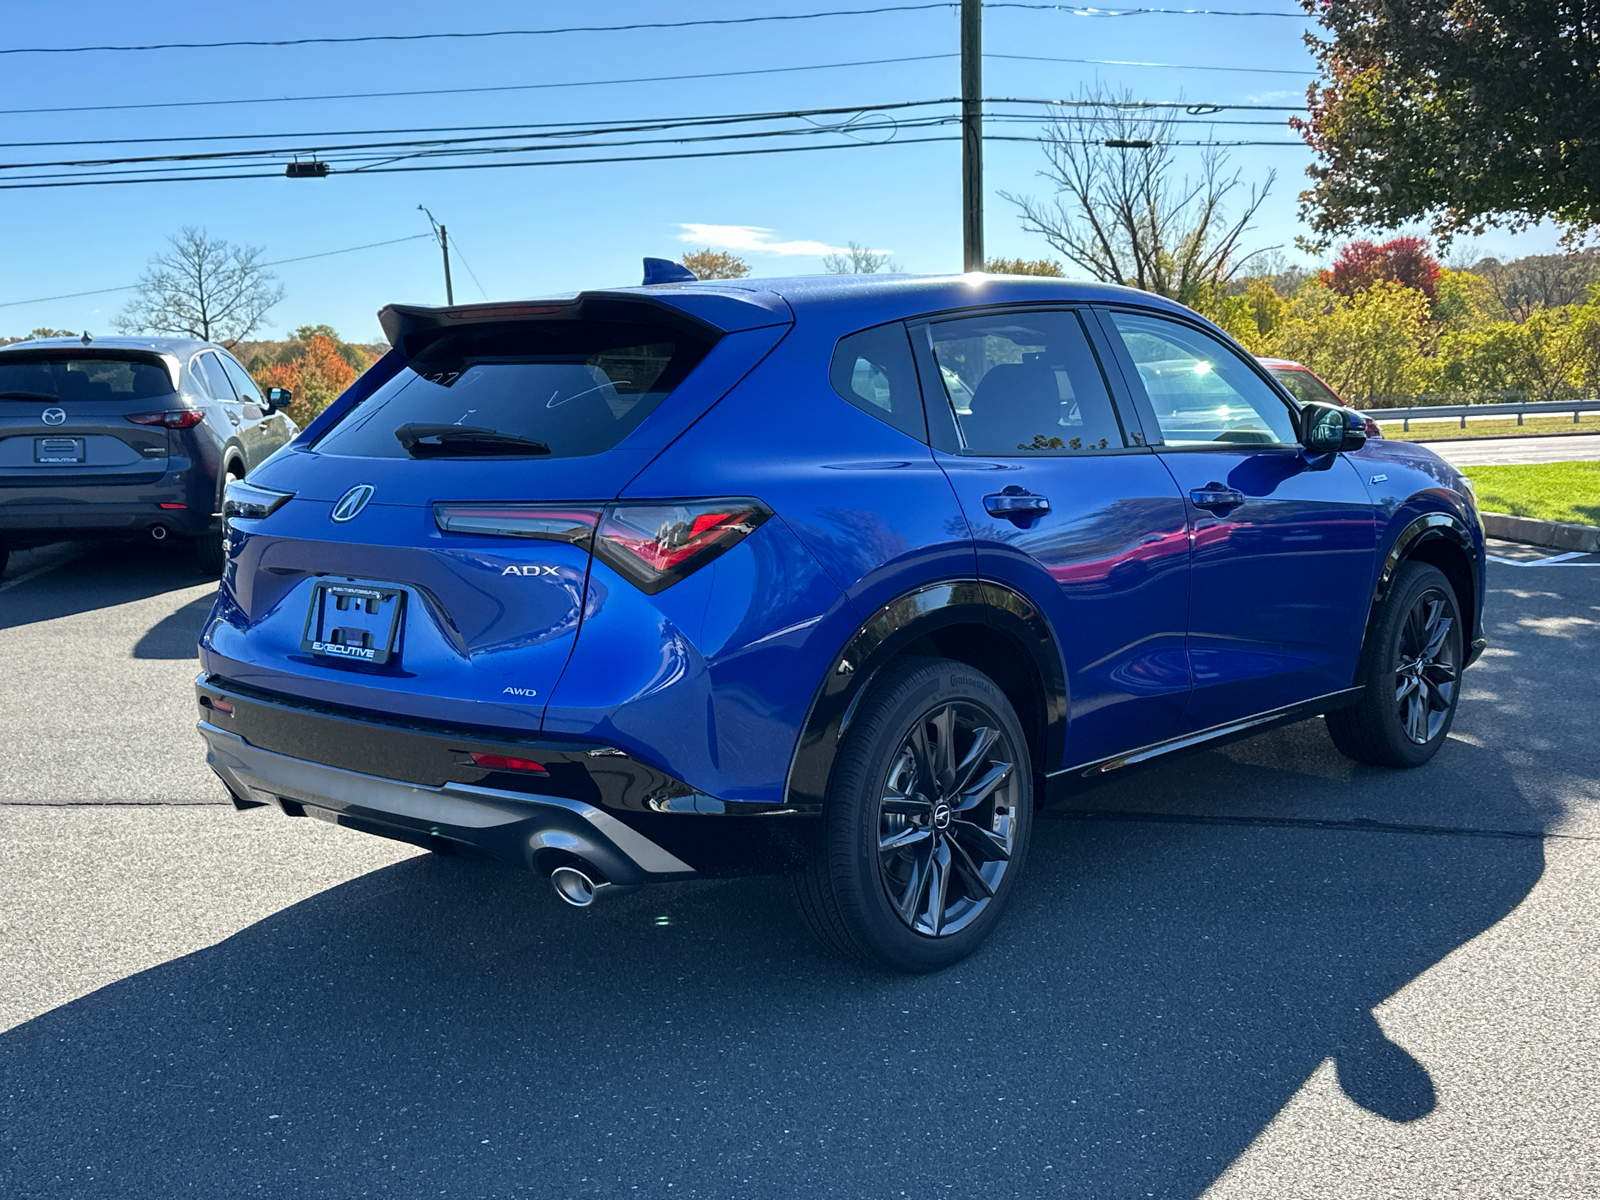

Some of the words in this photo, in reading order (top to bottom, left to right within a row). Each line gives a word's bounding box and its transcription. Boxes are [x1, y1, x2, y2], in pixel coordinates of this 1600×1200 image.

[501, 565, 560, 576] ADX
[312, 641, 375, 659] EXECUTIVE
[950, 674, 991, 693] Continental
[502, 686, 537, 697] AWD
